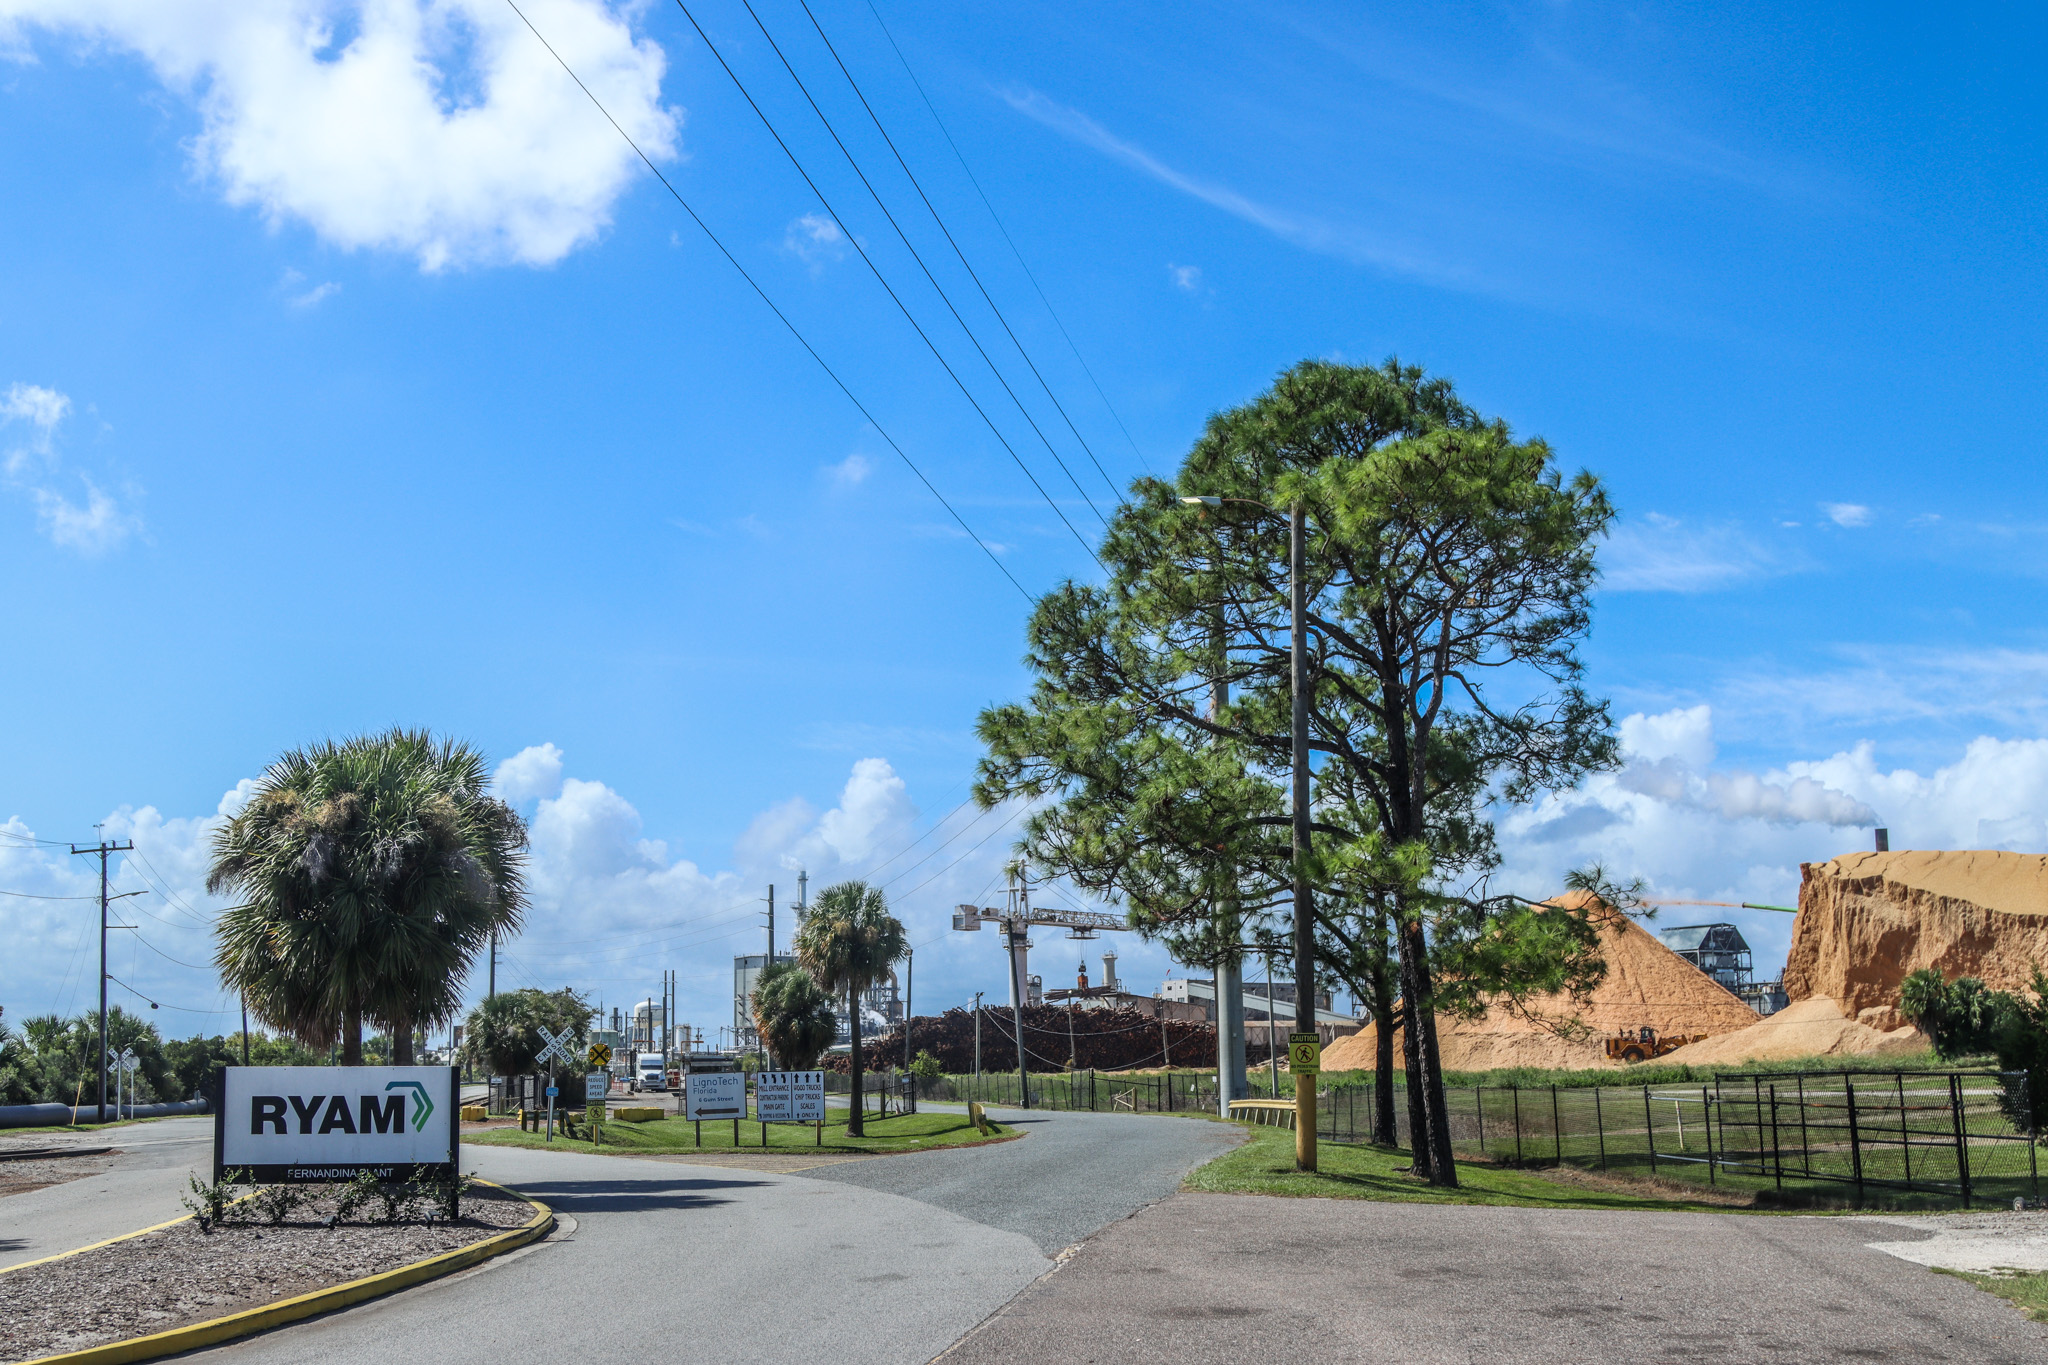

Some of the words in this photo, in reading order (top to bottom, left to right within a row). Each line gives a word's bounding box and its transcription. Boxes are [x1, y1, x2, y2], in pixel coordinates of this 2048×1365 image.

[692, 1076, 738, 1088] LignoTech
[251, 1095, 405, 1135] RYAM
[287, 1168, 357, 1178] FERNANDINA
